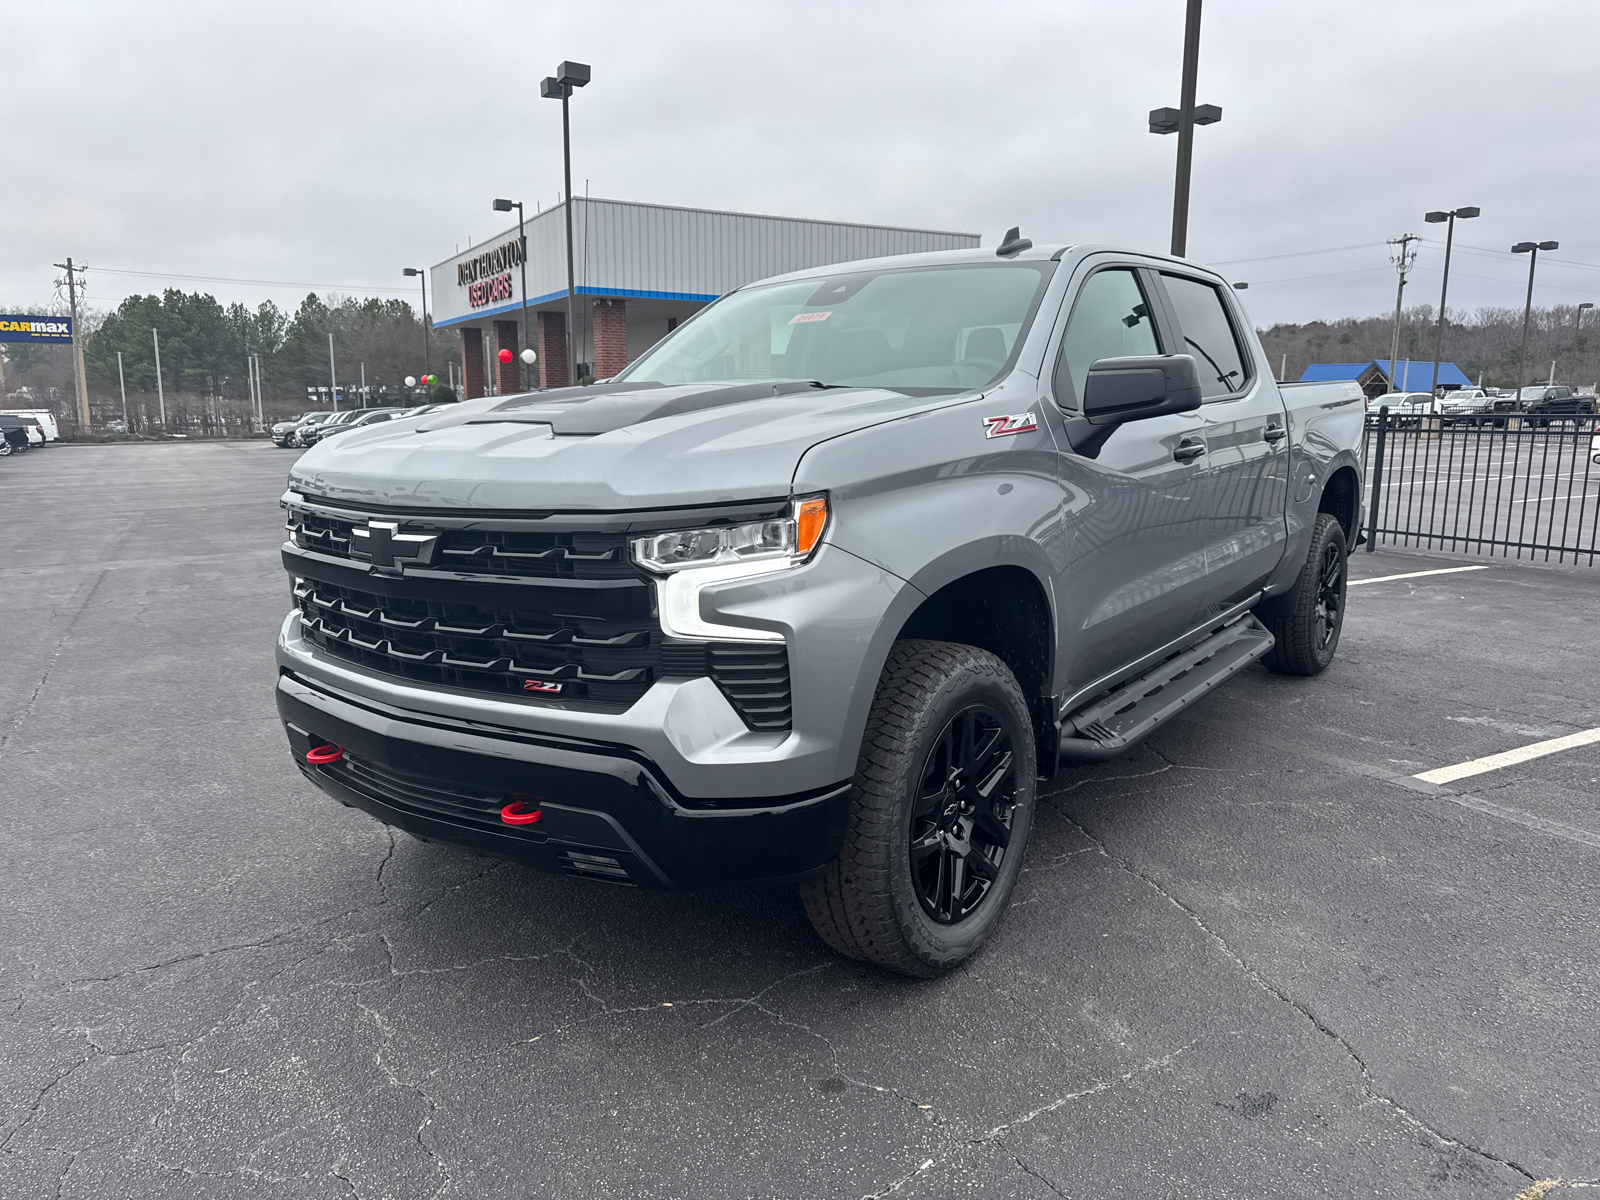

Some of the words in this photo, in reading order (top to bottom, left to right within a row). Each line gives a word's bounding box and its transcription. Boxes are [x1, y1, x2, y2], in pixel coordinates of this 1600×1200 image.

[457, 259, 478, 286] JOHN
[468, 281, 489, 308] USED
[488, 272, 513, 302] CARS
[982, 411, 1038, 439] Z71
[523, 679, 563, 693] Z71
